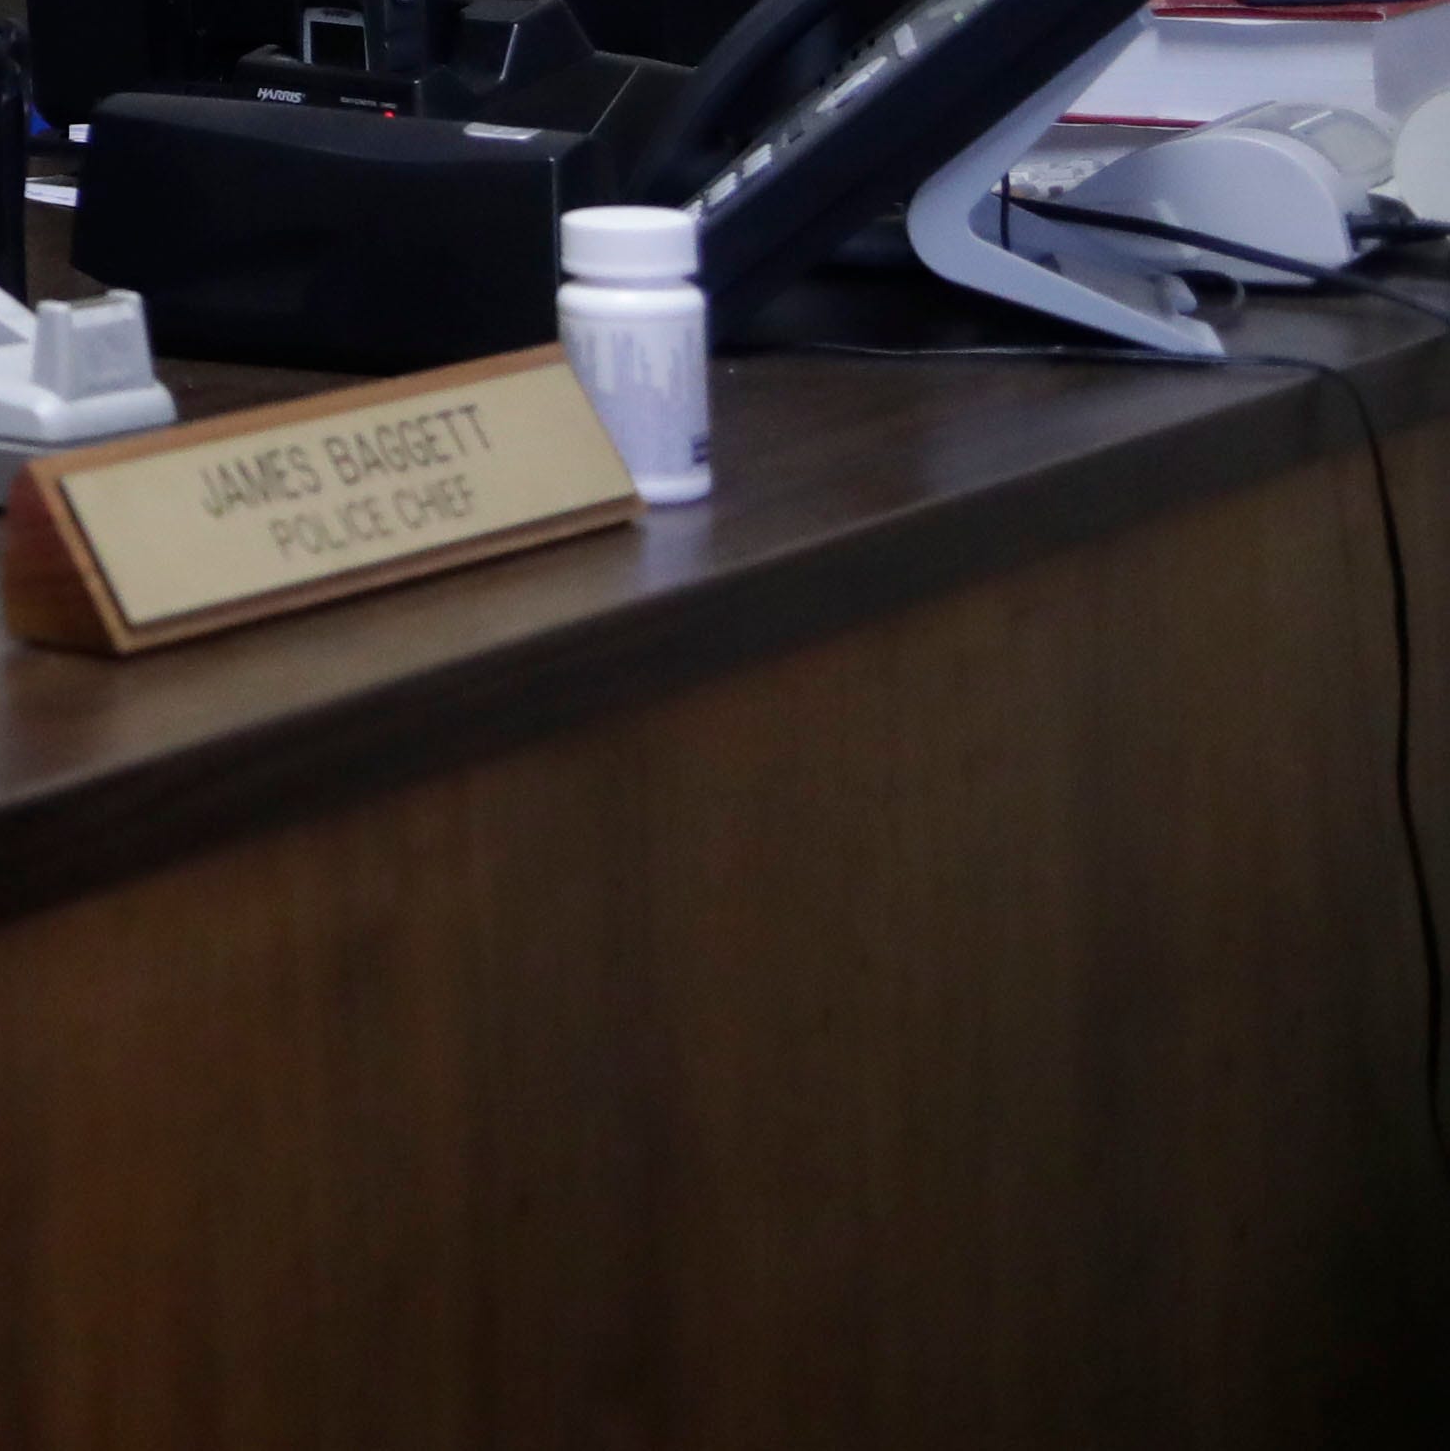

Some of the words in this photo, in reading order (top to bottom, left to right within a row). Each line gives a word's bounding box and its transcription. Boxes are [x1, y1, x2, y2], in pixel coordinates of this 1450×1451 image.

[256, 87, 303, 104] HARRIS
[201, 446, 323, 518] JAMES
[324, 404, 491, 485] BAGGETT
[269, 496, 393, 558] POLICE
[393, 474, 474, 529] CHIEF
